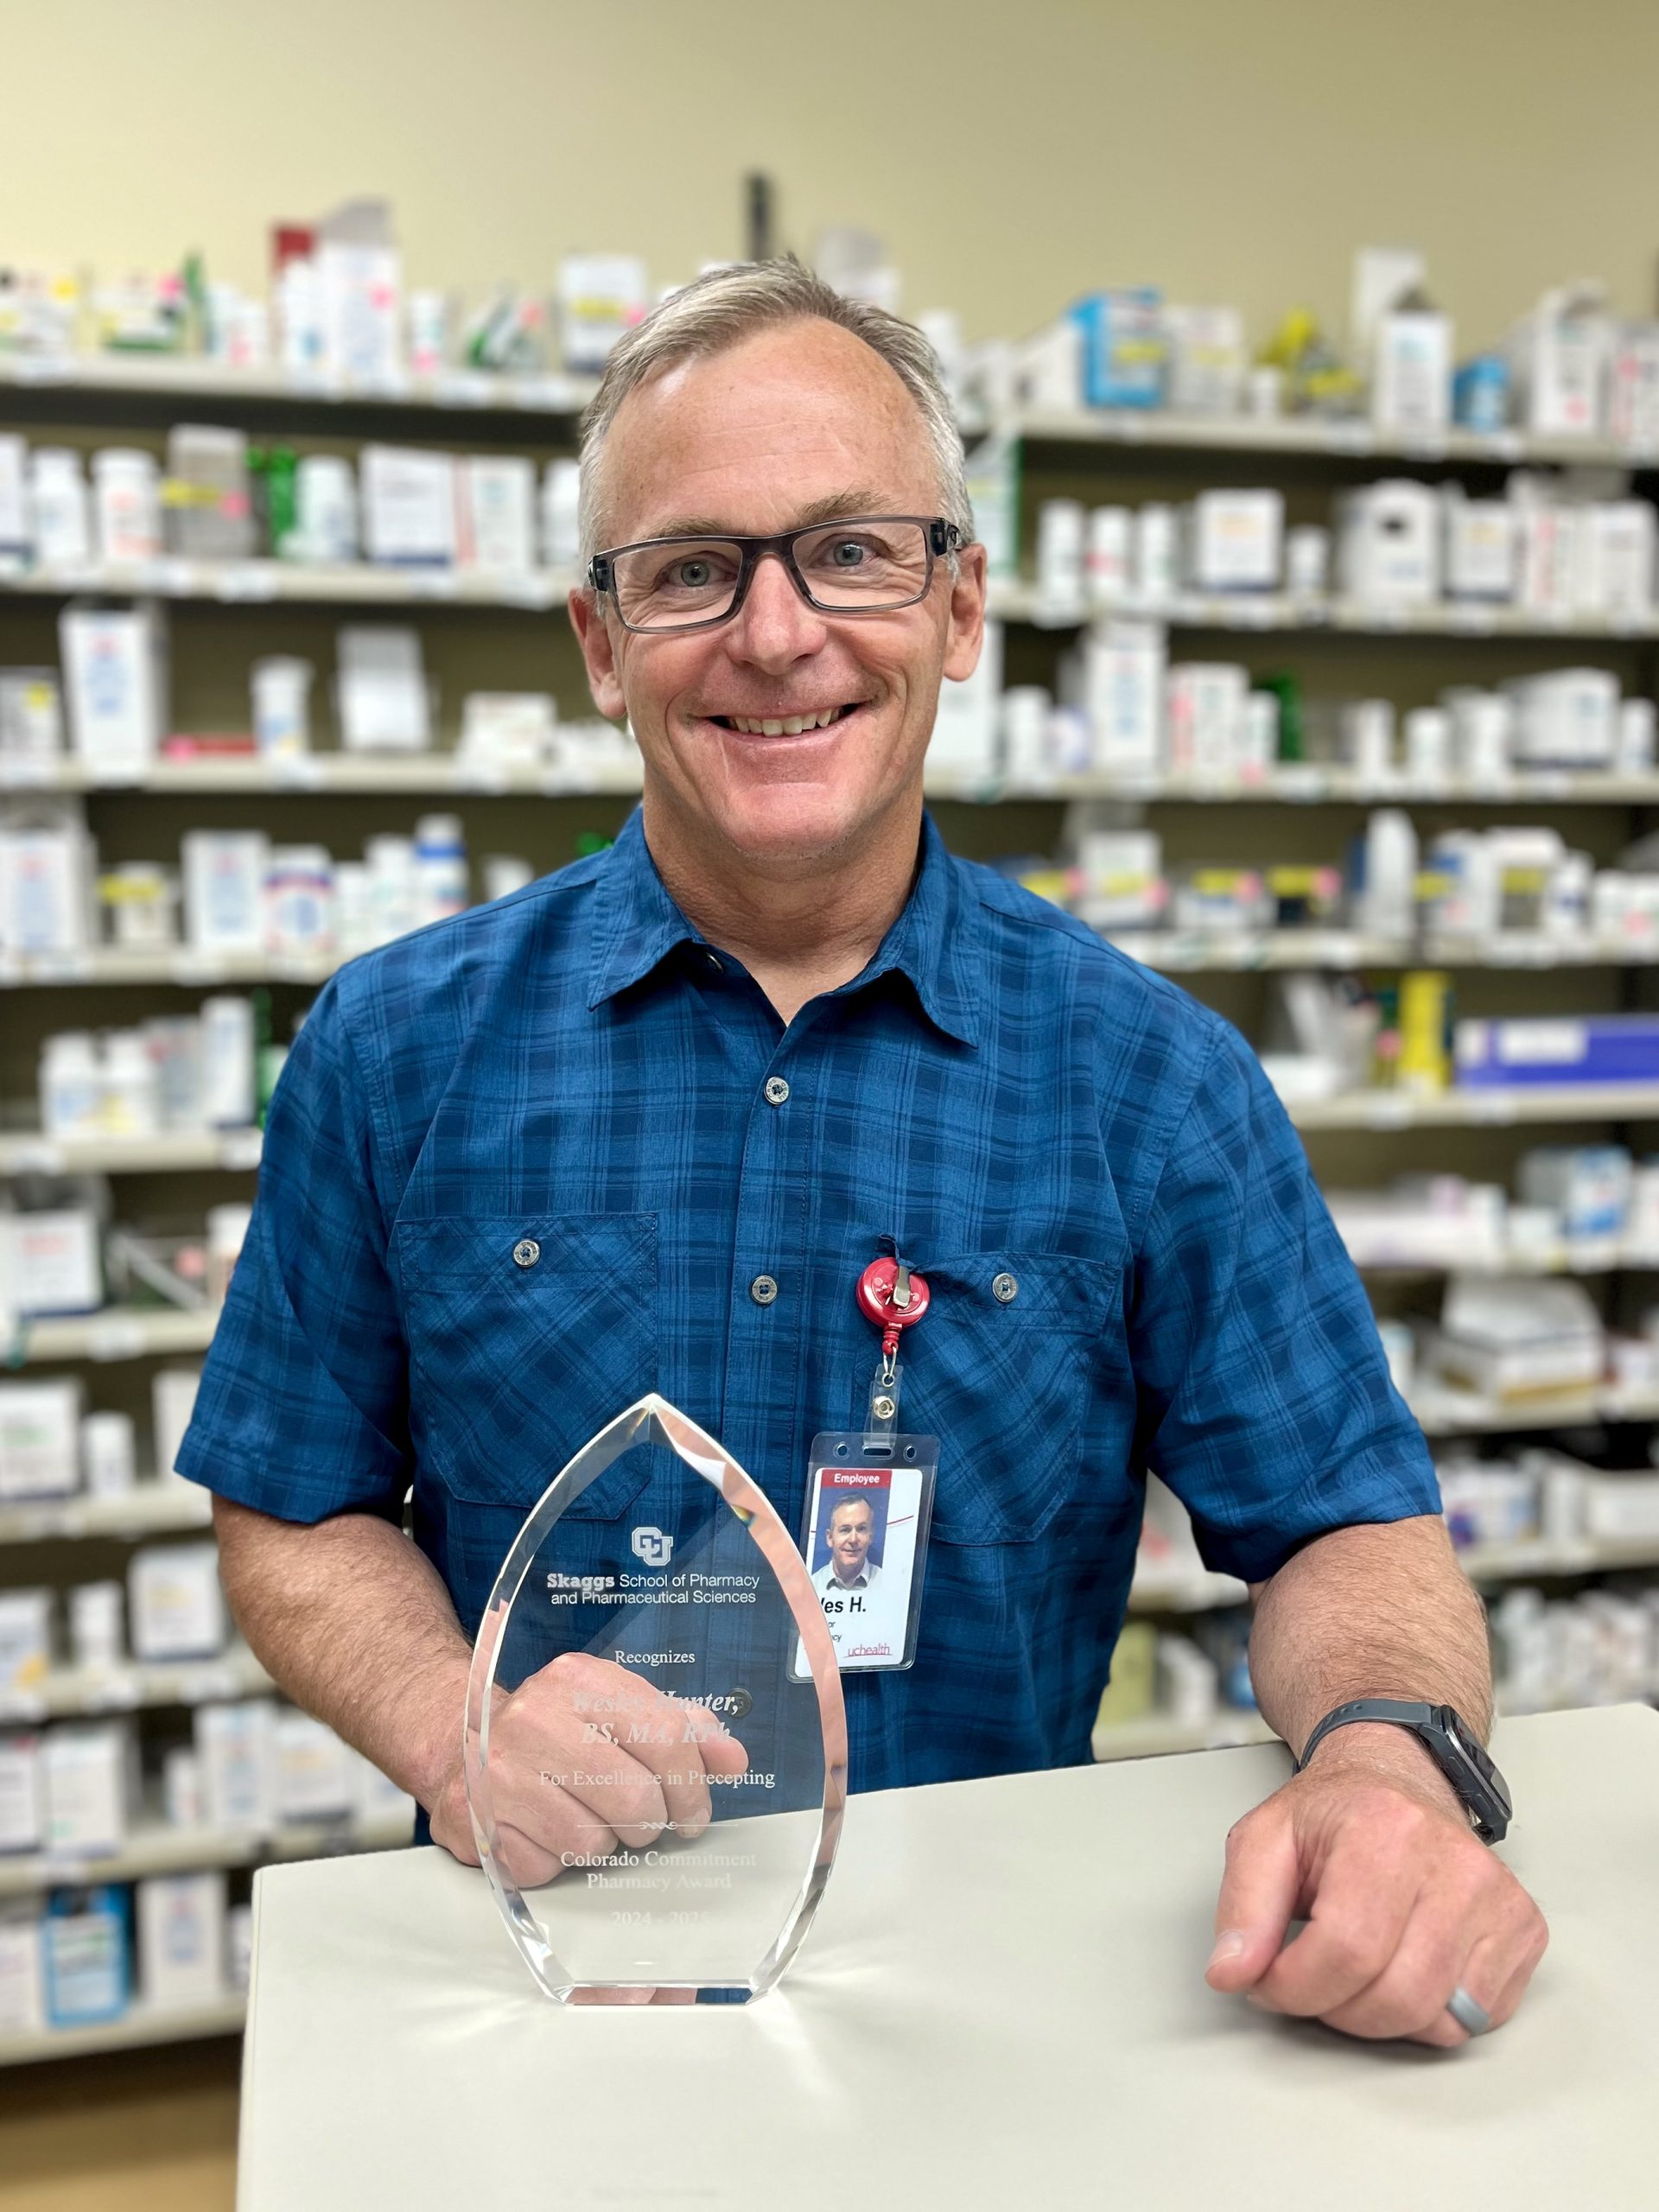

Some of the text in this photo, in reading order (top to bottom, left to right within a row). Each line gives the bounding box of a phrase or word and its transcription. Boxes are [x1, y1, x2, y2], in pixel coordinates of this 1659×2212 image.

[834, 1473, 880, 1484] Employee
[547, 1573, 760, 1591] Skaggs School of Pharmacy
[551, 1590, 756, 1605] and Pharmaceutical Sciences
[821, 1596, 867, 1613] es H.
[848, 1643, 891, 1656] uchealth
[615, 1650, 696, 1667] Recognizes
[658, 1690, 739, 1715] Hunter,
[582, 1722, 620, 1747] BS,
[626, 1722, 675, 1746] MA,
[539, 1771, 776, 1789] For Excellence in Precepting
[561, 1851, 757, 1867] Colorado Commitment
[587, 1873, 732, 1892] Pharmacy Award
